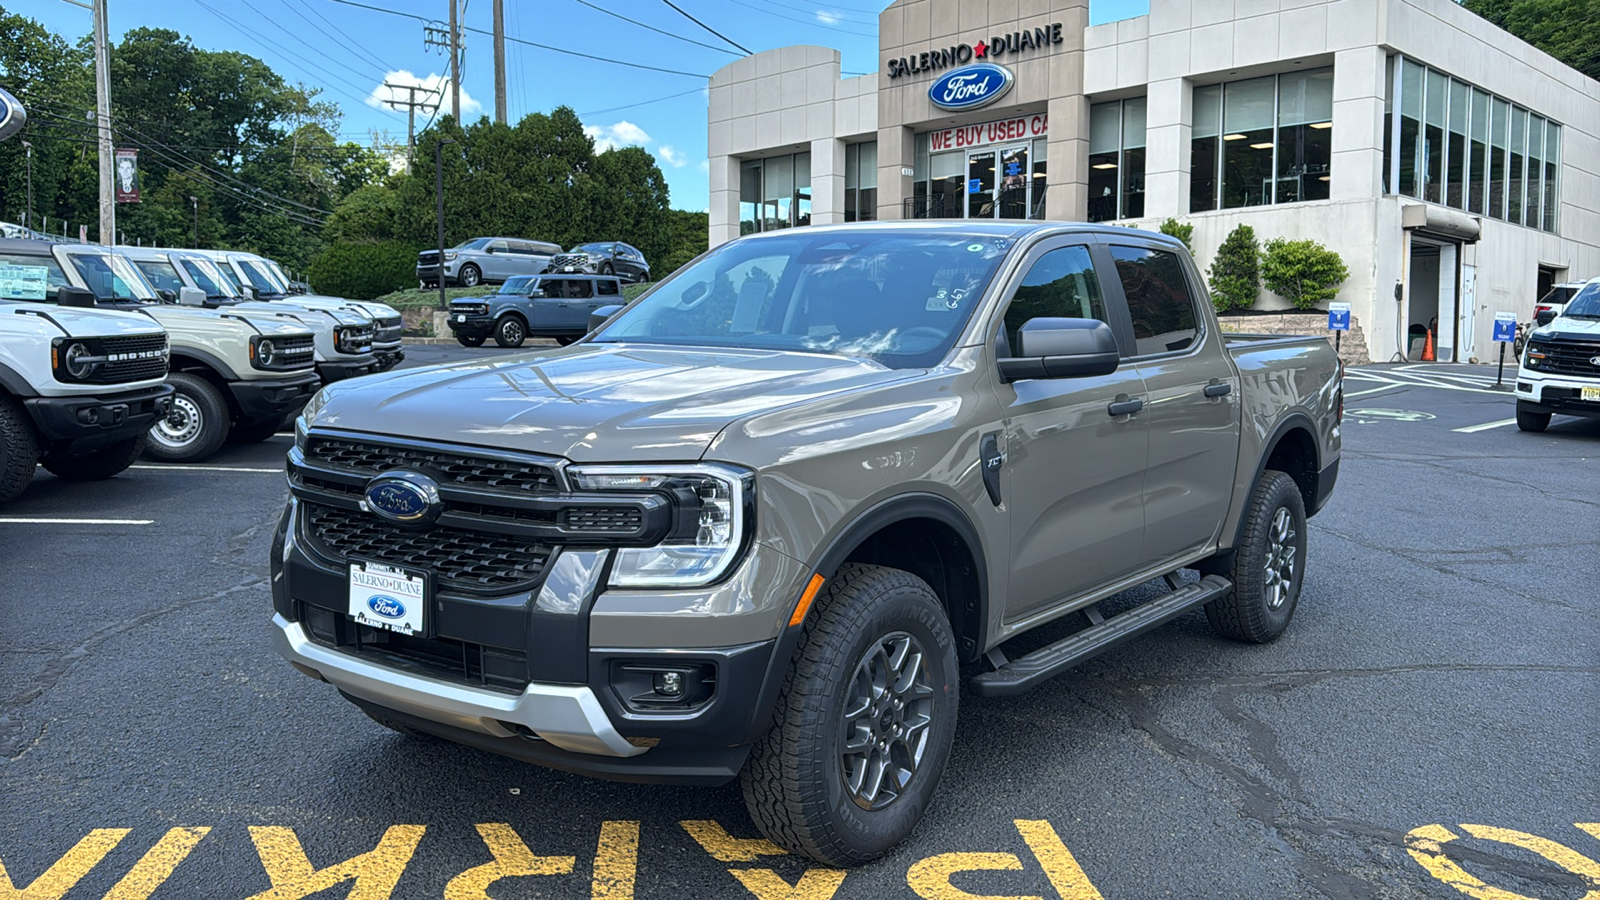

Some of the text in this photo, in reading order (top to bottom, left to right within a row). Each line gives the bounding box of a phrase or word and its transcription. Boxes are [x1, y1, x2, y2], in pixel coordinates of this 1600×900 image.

[887, 22, 1064, 78] SALERNO DUANE
[943, 73, 990, 102] Ford
[931, 130, 952, 150] WE
[956, 125, 984, 146] BUY
[988, 118, 1027, 142] USED
[108, 350, 161, 362] BRONCO
[352, 571, 422, 596] SALERNO DUANE
[374, 597, 399, 616] Ford
